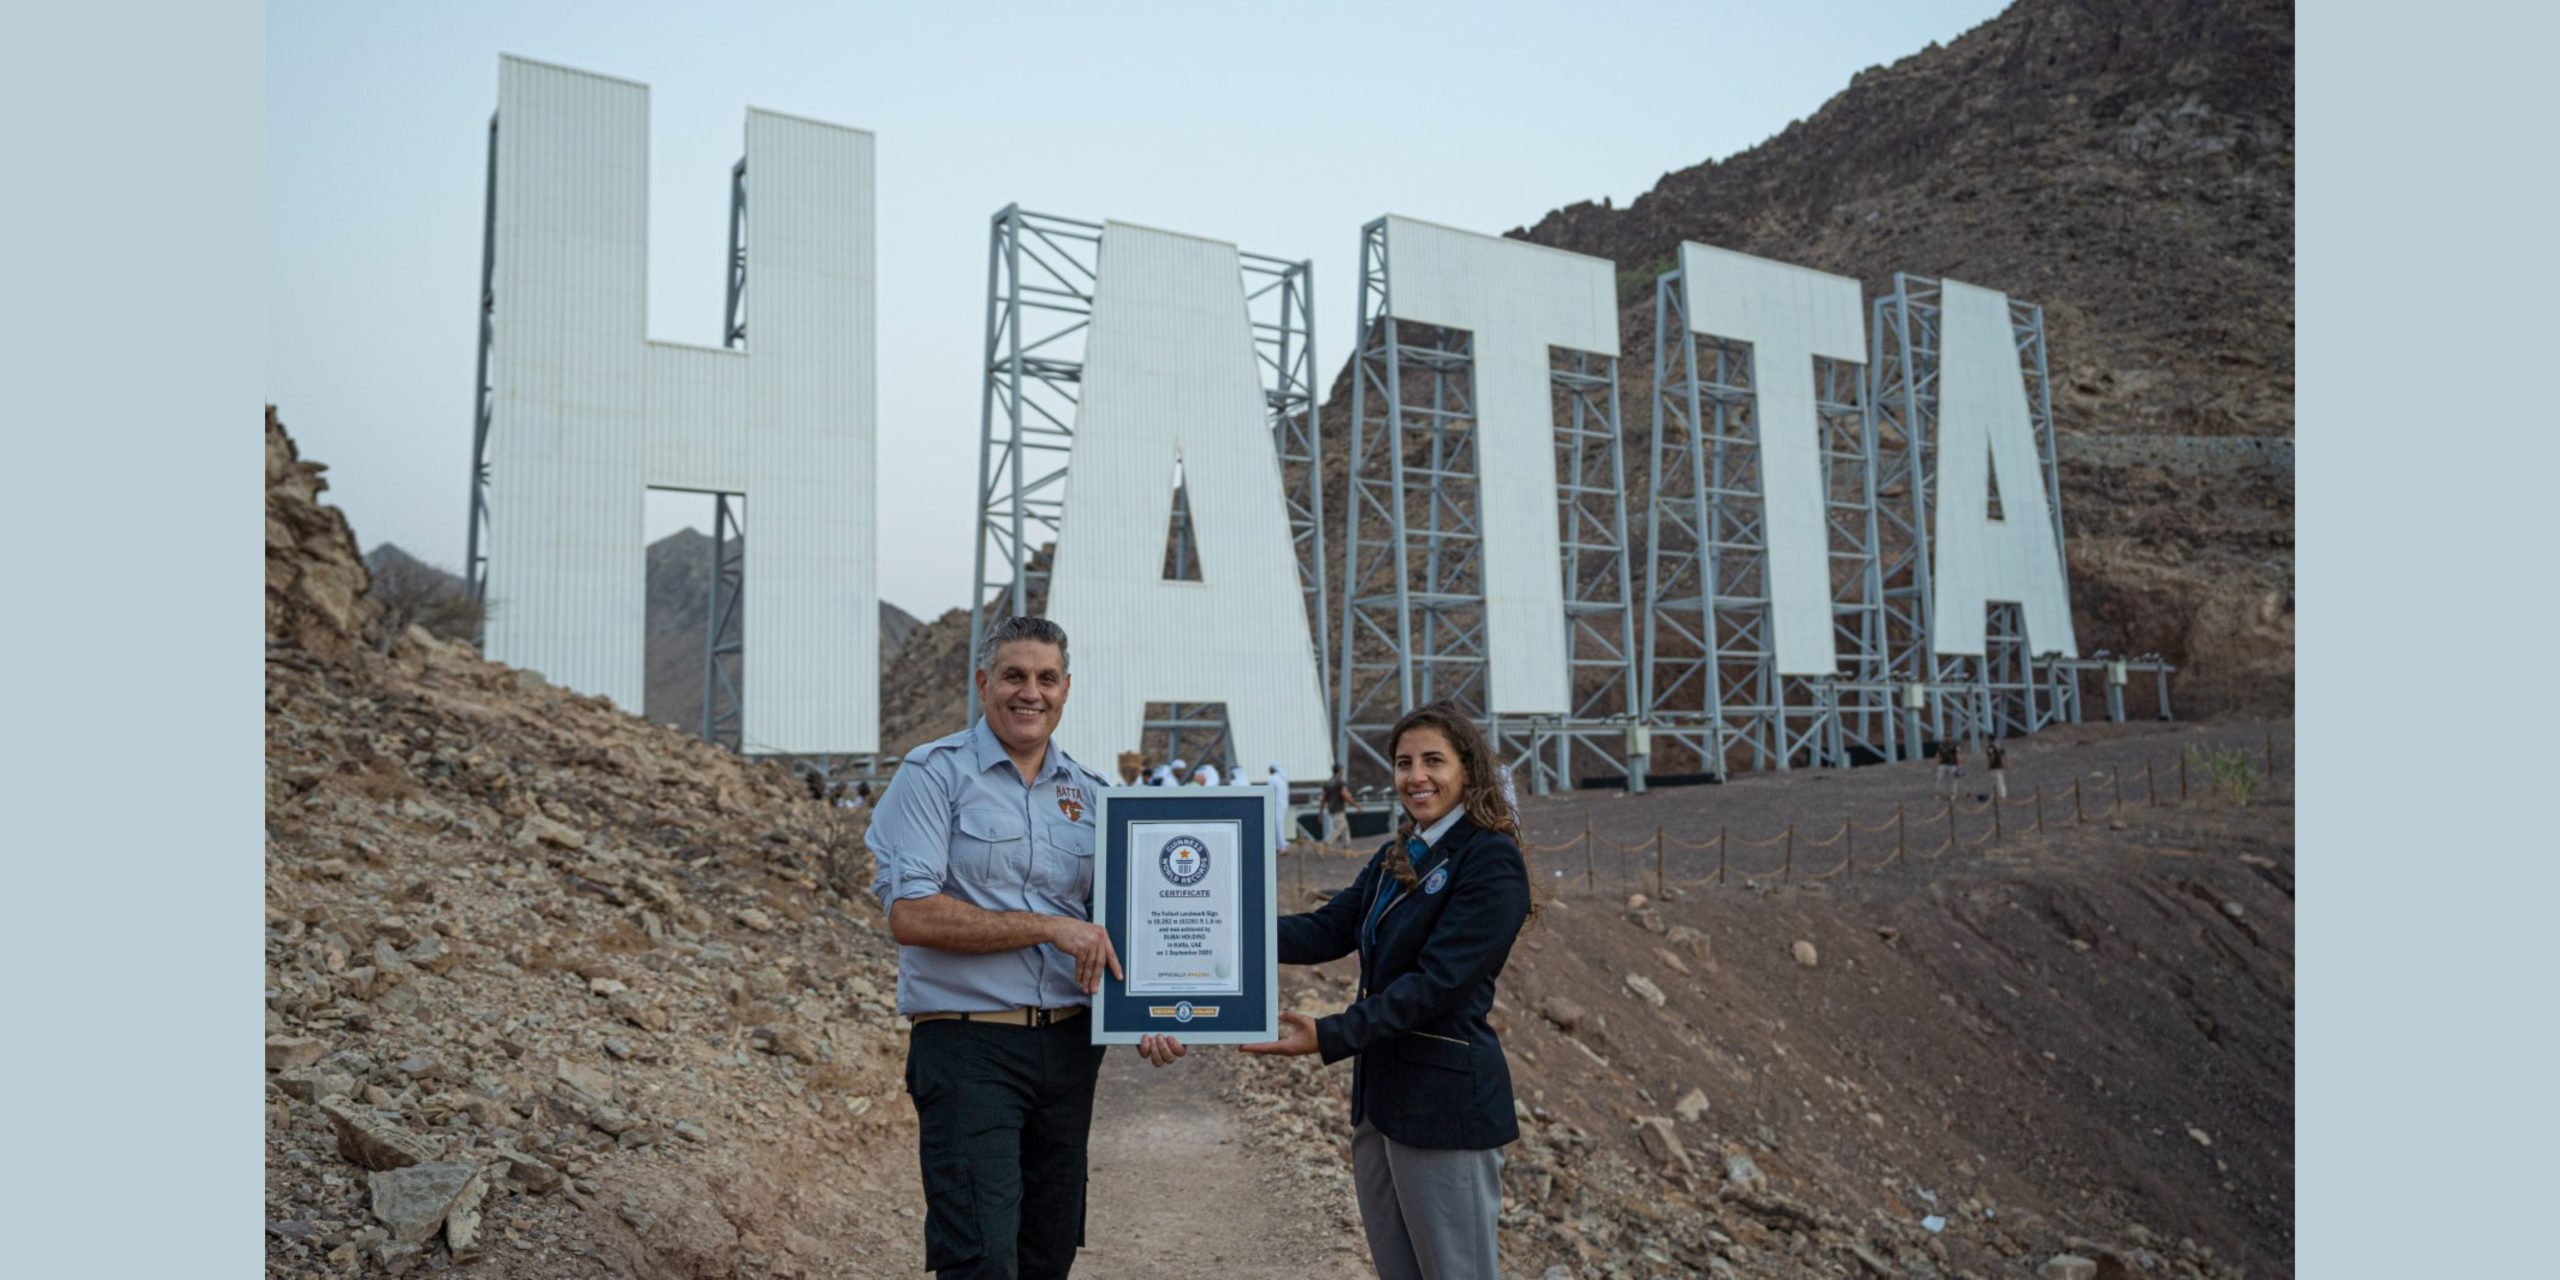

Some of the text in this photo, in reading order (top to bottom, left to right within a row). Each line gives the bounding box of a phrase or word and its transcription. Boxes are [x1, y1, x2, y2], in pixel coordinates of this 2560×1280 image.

[482, 54, 2078, 783] HATTA
[1055, 785, 1083, 802] HATTA
[1166, 838, 1204, 853] GUINNESS
[1162, 857, 1208, 884] WORLD RECORDS
[1159, 890, 1211, 898] CERTIFICATE
